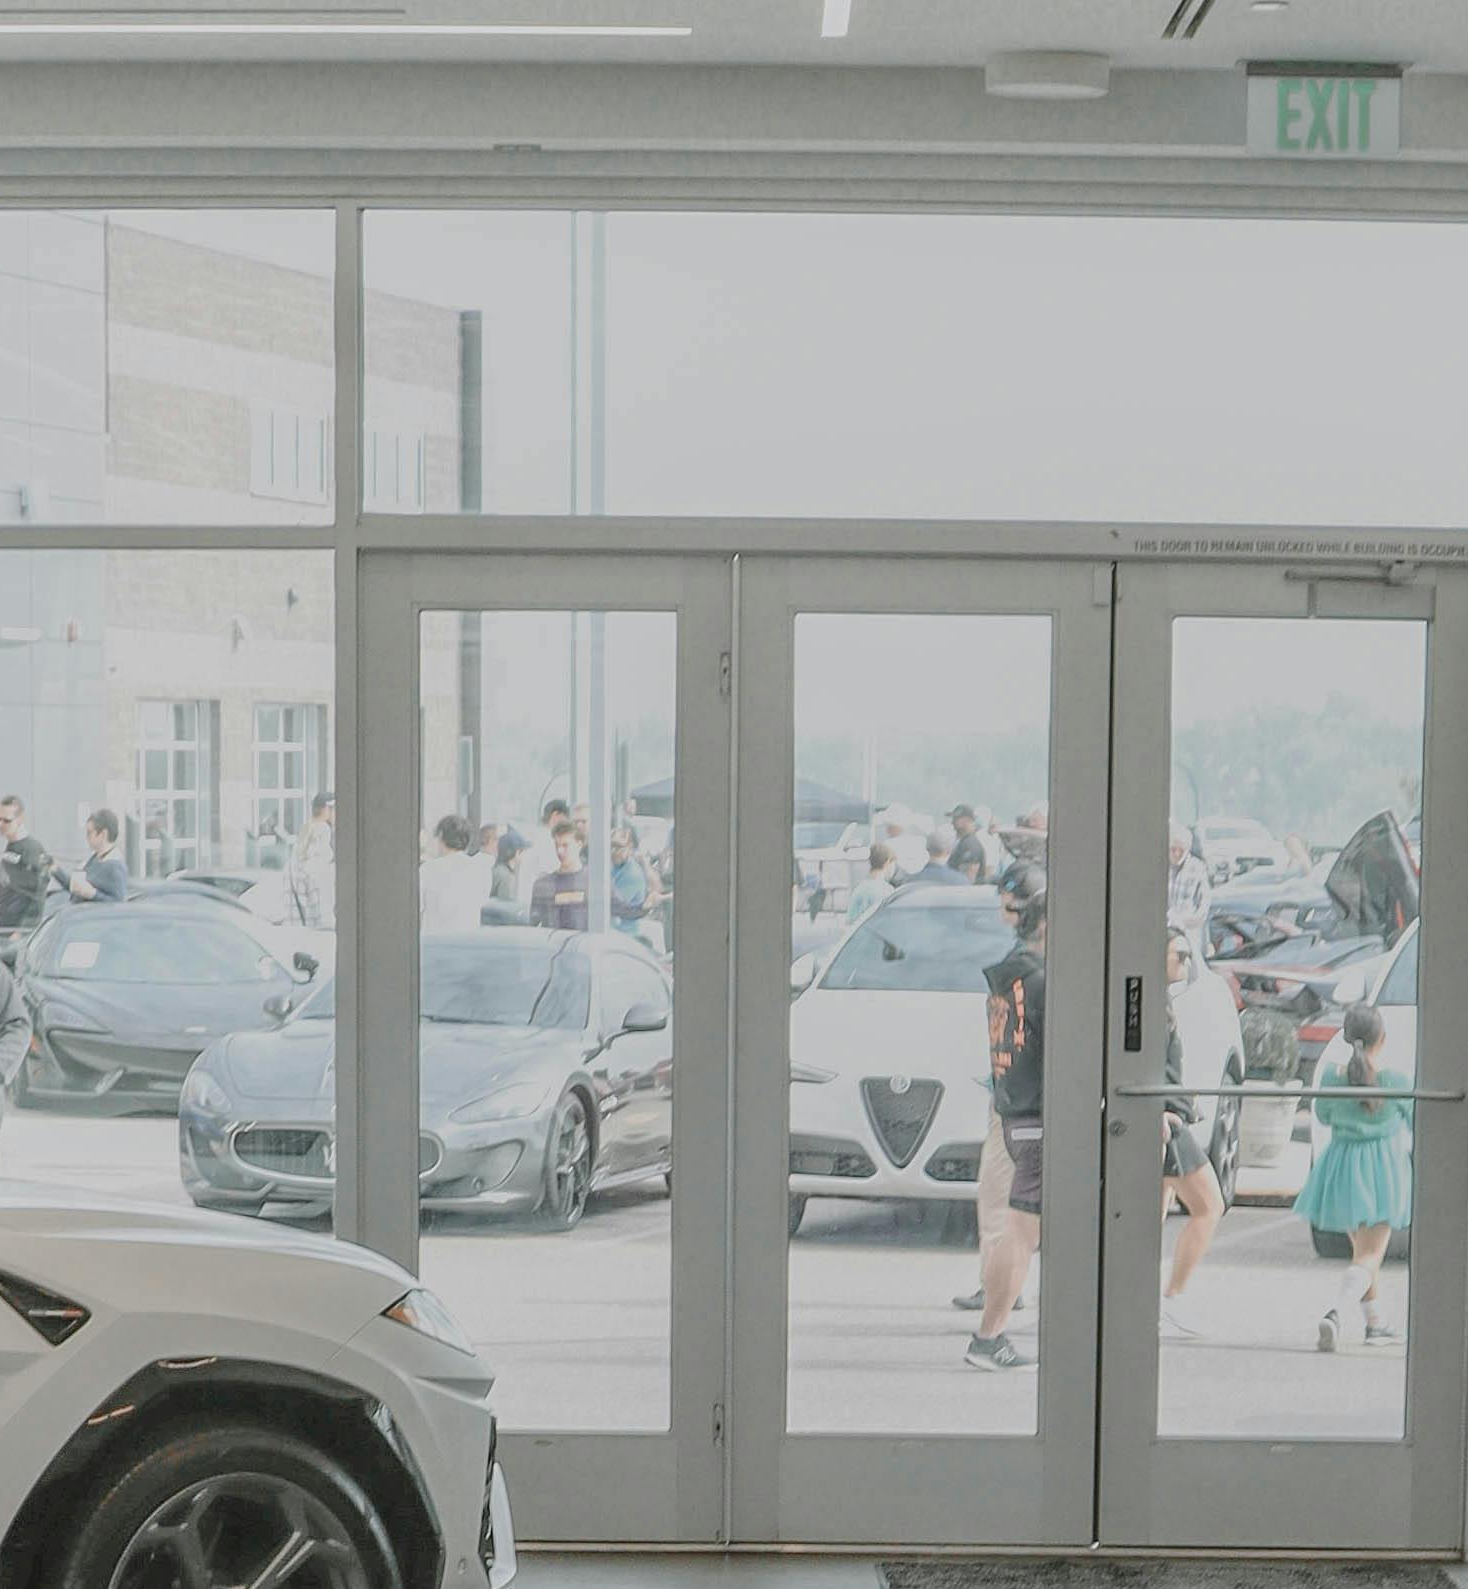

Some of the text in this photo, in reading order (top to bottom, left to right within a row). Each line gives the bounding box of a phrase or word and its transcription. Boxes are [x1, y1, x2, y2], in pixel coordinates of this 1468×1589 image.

[1277, 79, 1376, 152] EXIT
[1134, 540, 1158, 553] THIS
[1161, 540, 1191, 553] DOOR
[1195, 540, 1208, 553] TO
[1211, 540, 1253, 553] REMAIN
[1256, 541, 1314, 554] UNLOCKED
[1316, 542, 1351, 554] WHILE
[1354, 543, 1404, 556] BUILDING
[1407, 544, 1418, 556] IS
